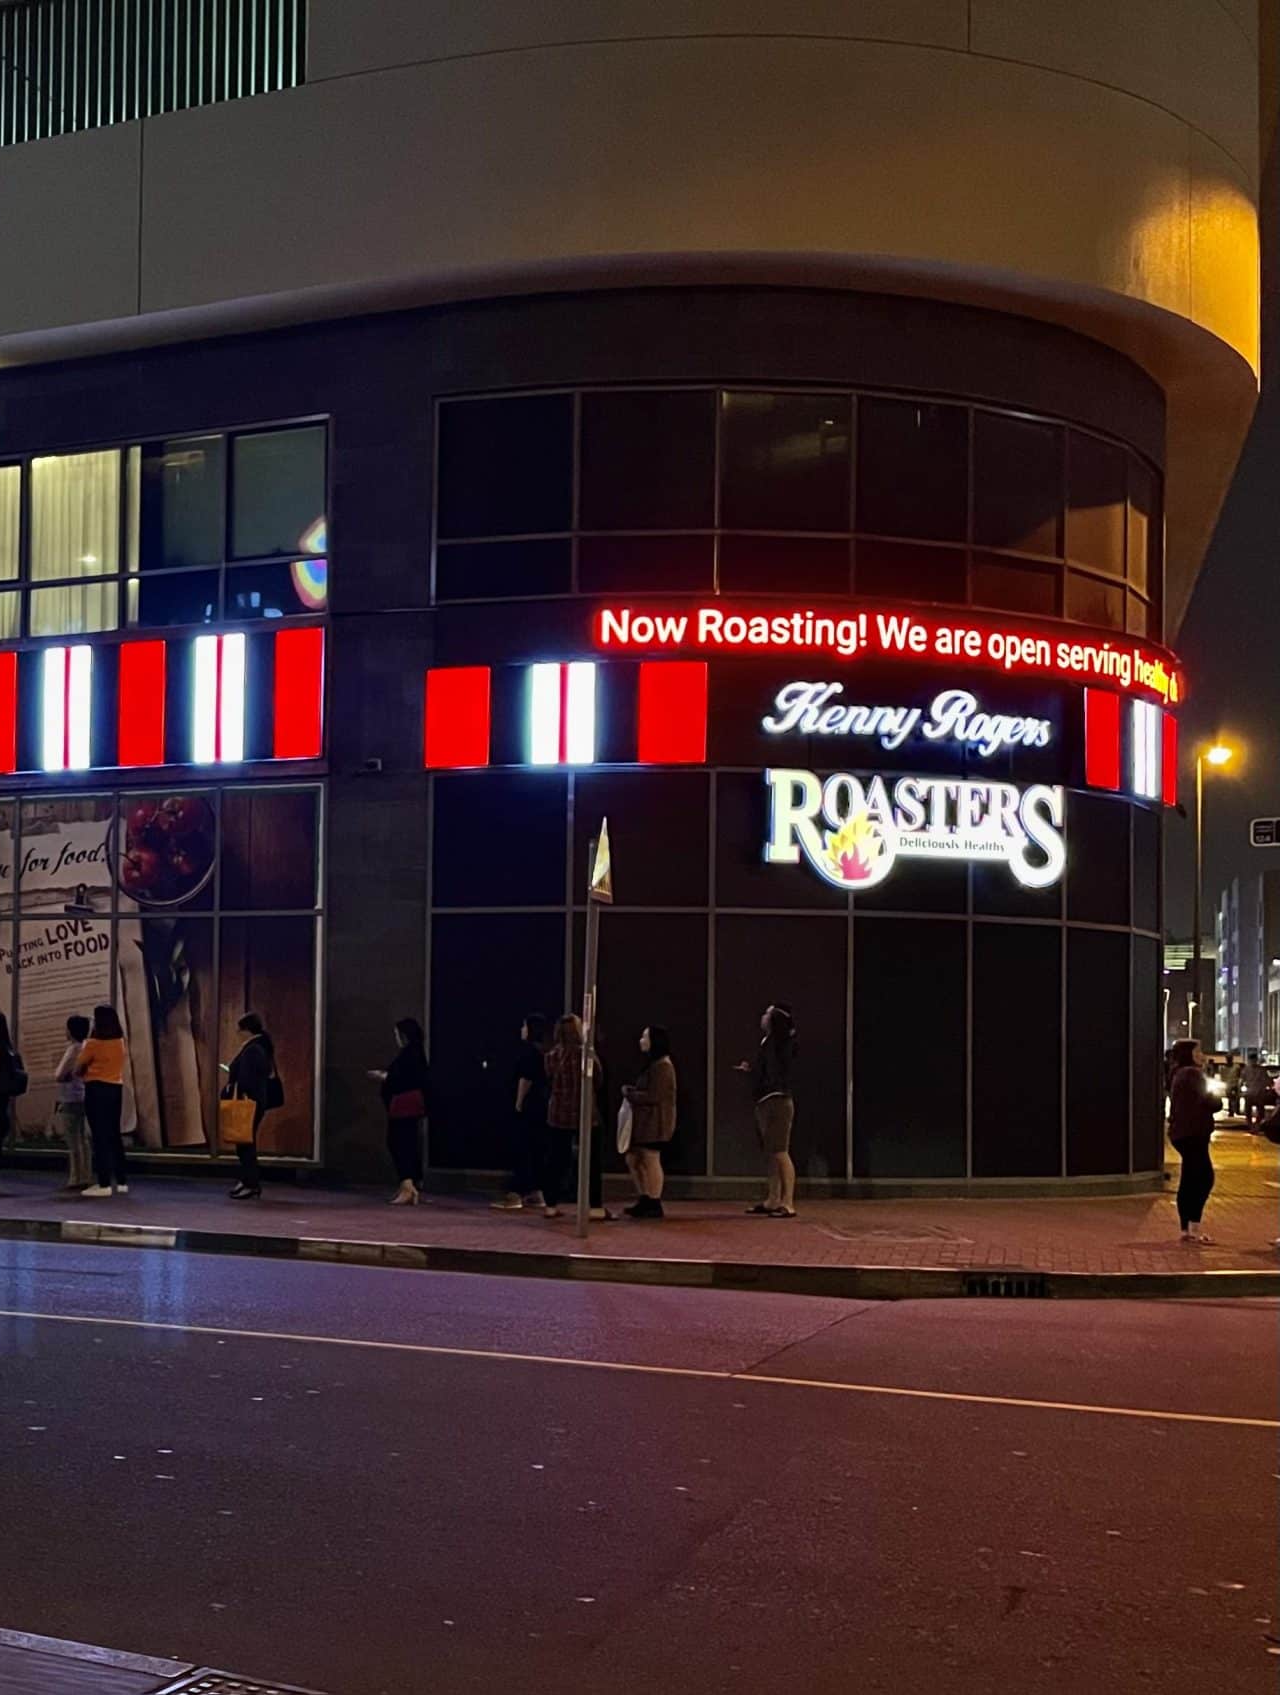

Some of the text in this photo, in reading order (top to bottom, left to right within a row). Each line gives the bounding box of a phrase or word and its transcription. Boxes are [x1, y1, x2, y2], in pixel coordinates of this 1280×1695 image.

[600, 608, 688, 644] Now
[698, 608, 868, 655] Roasting!
[876, 614, 928, 651] We
[935, 627, 982, 656] are
[988, 633, 1051, 669] open
[1057, 643, 1131, 687] serving
[762, 681, 1051, 757] Kenny Rogers
[764, 767, 1067, 889] ROASTERS
[19, 847, 50, 880] for
[45, 919, 93, 945] LOVE
[64, 932, 110, 961] FOOD
